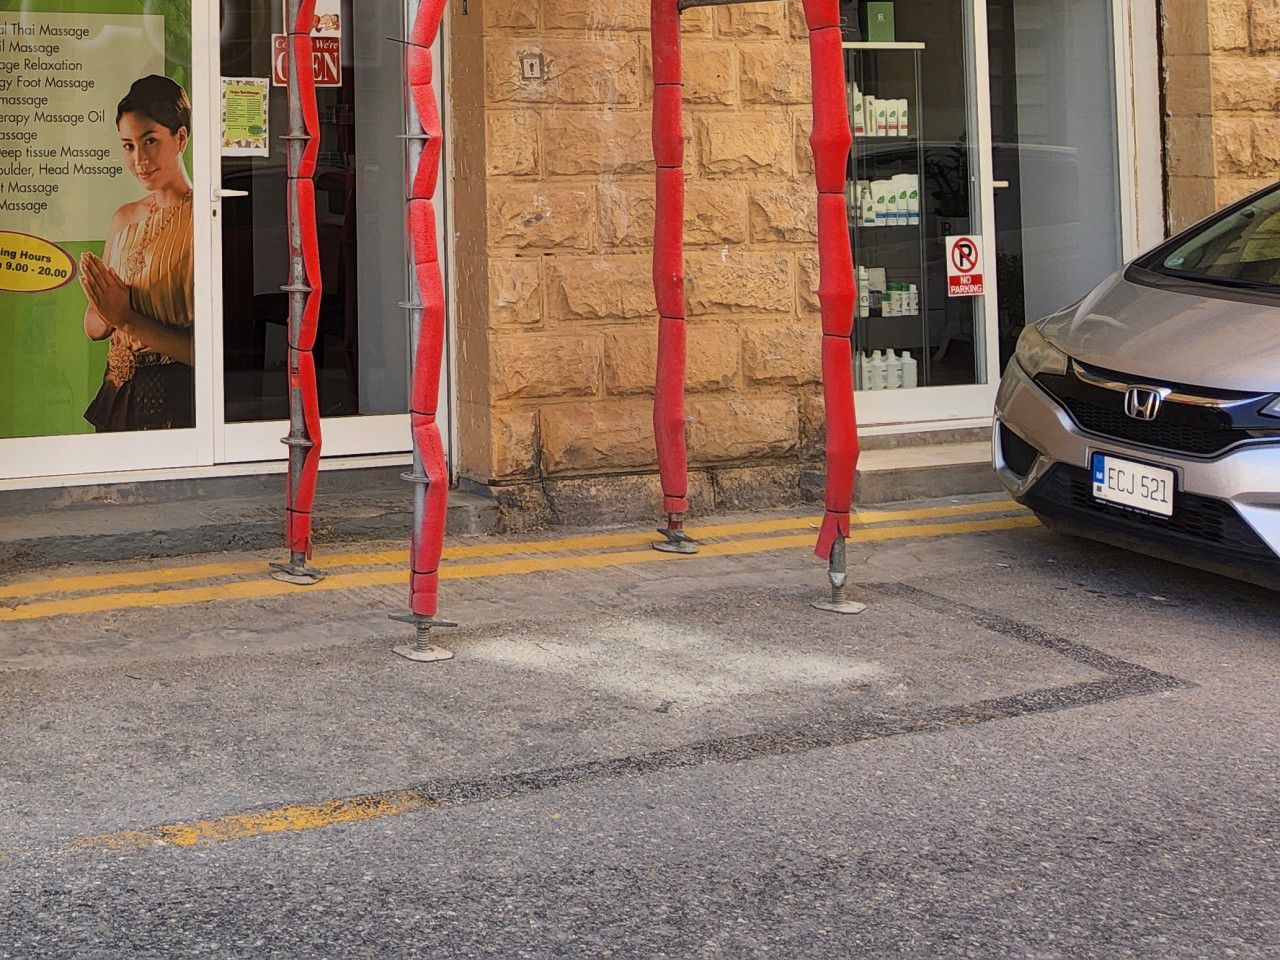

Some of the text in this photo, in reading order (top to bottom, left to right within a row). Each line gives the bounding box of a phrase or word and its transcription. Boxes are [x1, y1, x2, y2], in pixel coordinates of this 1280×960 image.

[11, 23, 35, 36] Thai
[39, 25, 90, 40] Massage
[9, 42, 60, 56] Massage
[316, 40, 339, 49] We're
[24, 59, 83, 71] Relaxation
[17, 76, 41, 88] Foot
[44, 77, 95, 91] Massage
[34, 112, 84, 125] Massage
[88, 110, 105, 123] Oil
[26, 147, 57, 158] tissue
[60, 147, 110, 160] Massage
[39, 163, 69, 175] Head
[73, 164, 123, 177] Massage
[8, 183, 59, 197] Massage
[20, 250, 52, 263] Hours
[5, 261, 28, 272] 9.00
[38, 266, 67, 278] 20.00
[960, 276, 971, 284] NO
[950, 284, 982, 293] PARKING
[1108, 467, 1168, 503] ECJ 521
